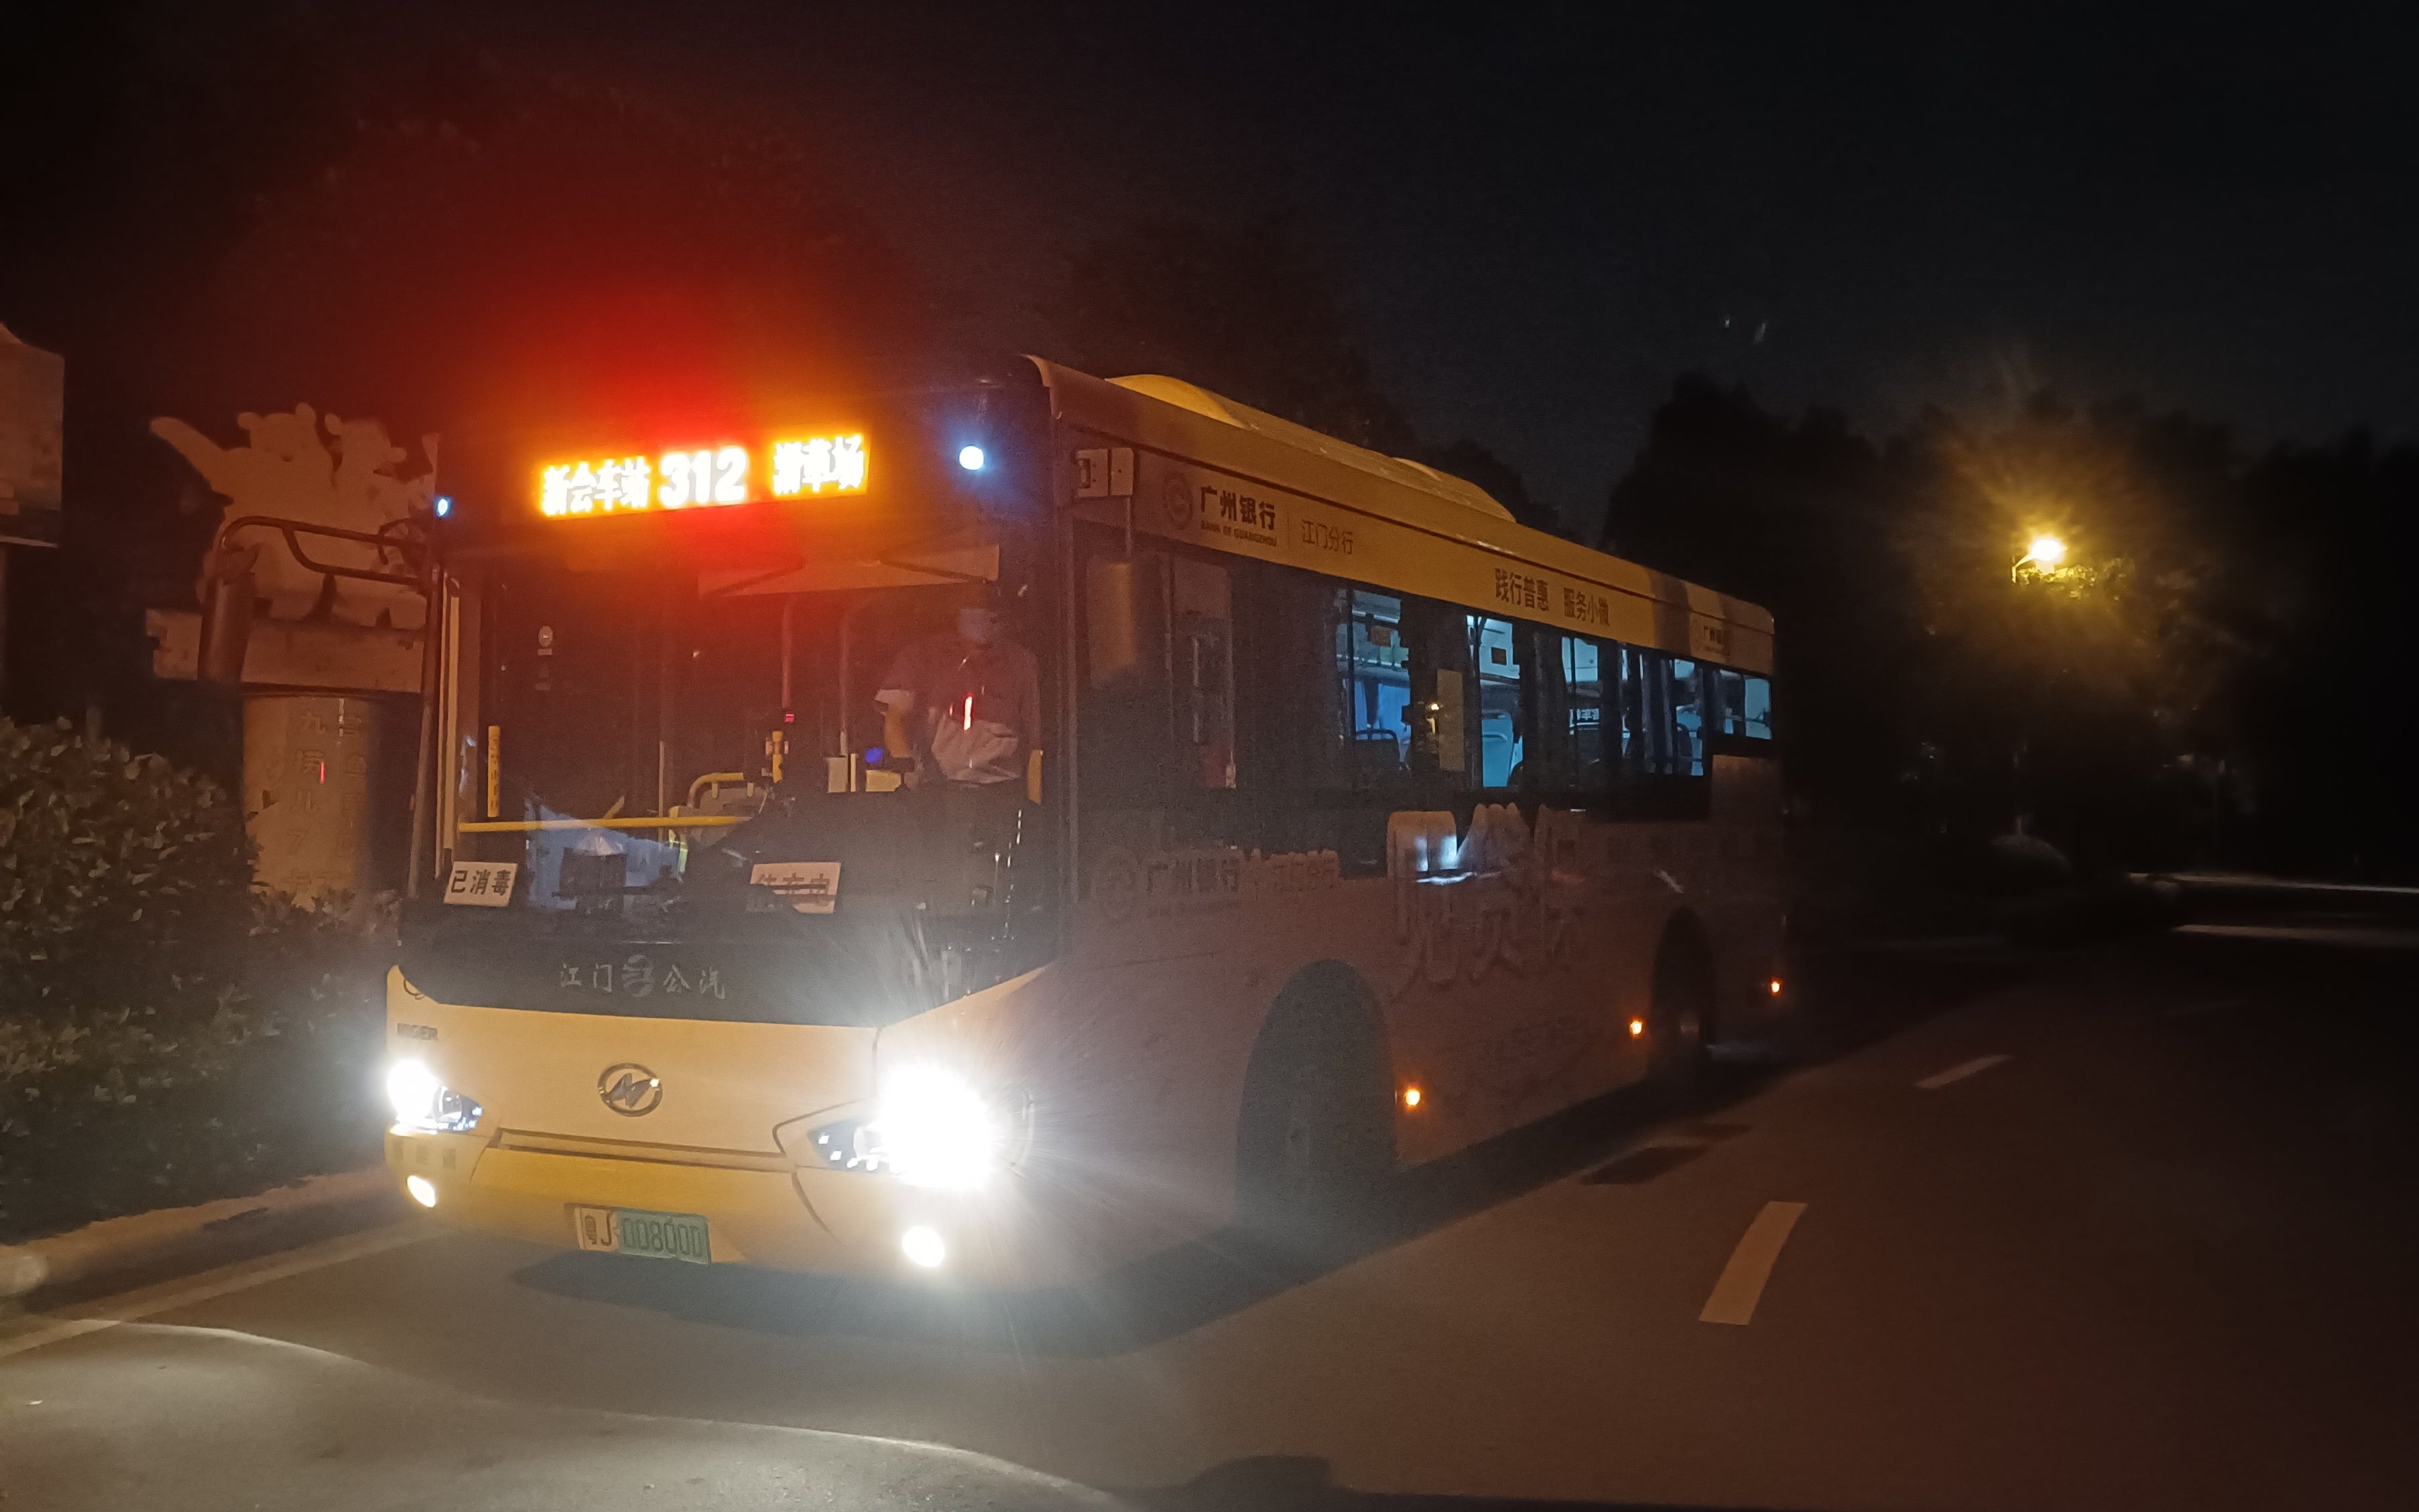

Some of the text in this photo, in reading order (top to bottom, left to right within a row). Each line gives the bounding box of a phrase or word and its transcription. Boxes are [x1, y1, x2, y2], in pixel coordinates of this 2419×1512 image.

[660, 448, 747, 508] 312
[1200, 485, 1276, 531] 广州银行
[1302, 518, 1354, 555] 江门分行
[1495, 568, 1610, 627] 践行普惠 服务小微
[451, 869, 511, 896] 已消毒
[560, 962, 726, 1001] 江门 公汽
